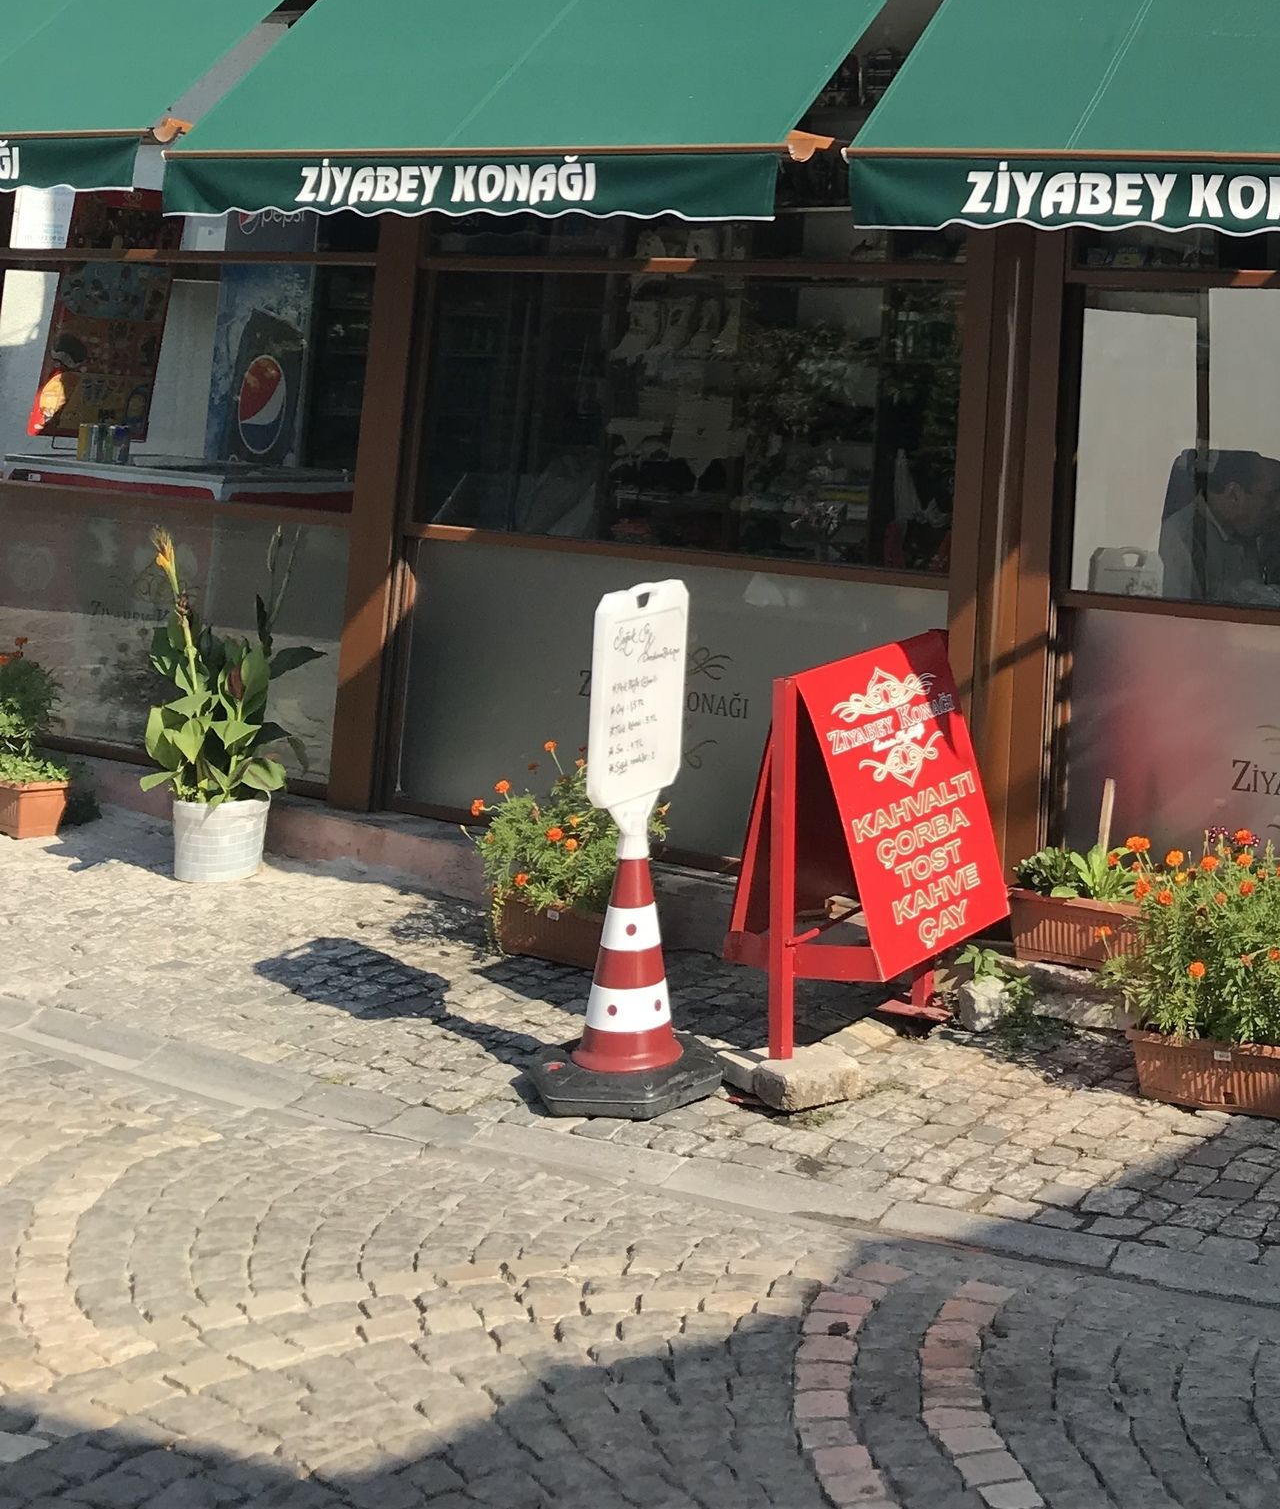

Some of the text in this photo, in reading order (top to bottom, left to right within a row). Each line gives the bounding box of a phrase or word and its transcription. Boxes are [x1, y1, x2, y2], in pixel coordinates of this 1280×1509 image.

[294, 155, 597, 206] ZİYABEY KONAĞI
[961, 161, 1177, 222] ZİYABEY
[687, 692, 749, 719] ONAĞI
[895, 691, 956, 730] KONAĞI
[851, 771, 977, 844] KAHVALTI
[876, 807, 971, 870] ÇORBA
[894, 838, 962, 888] TOST
[891, 862, 981, 926] KAHVE
[918, 899, 968, 949] ÇAY
